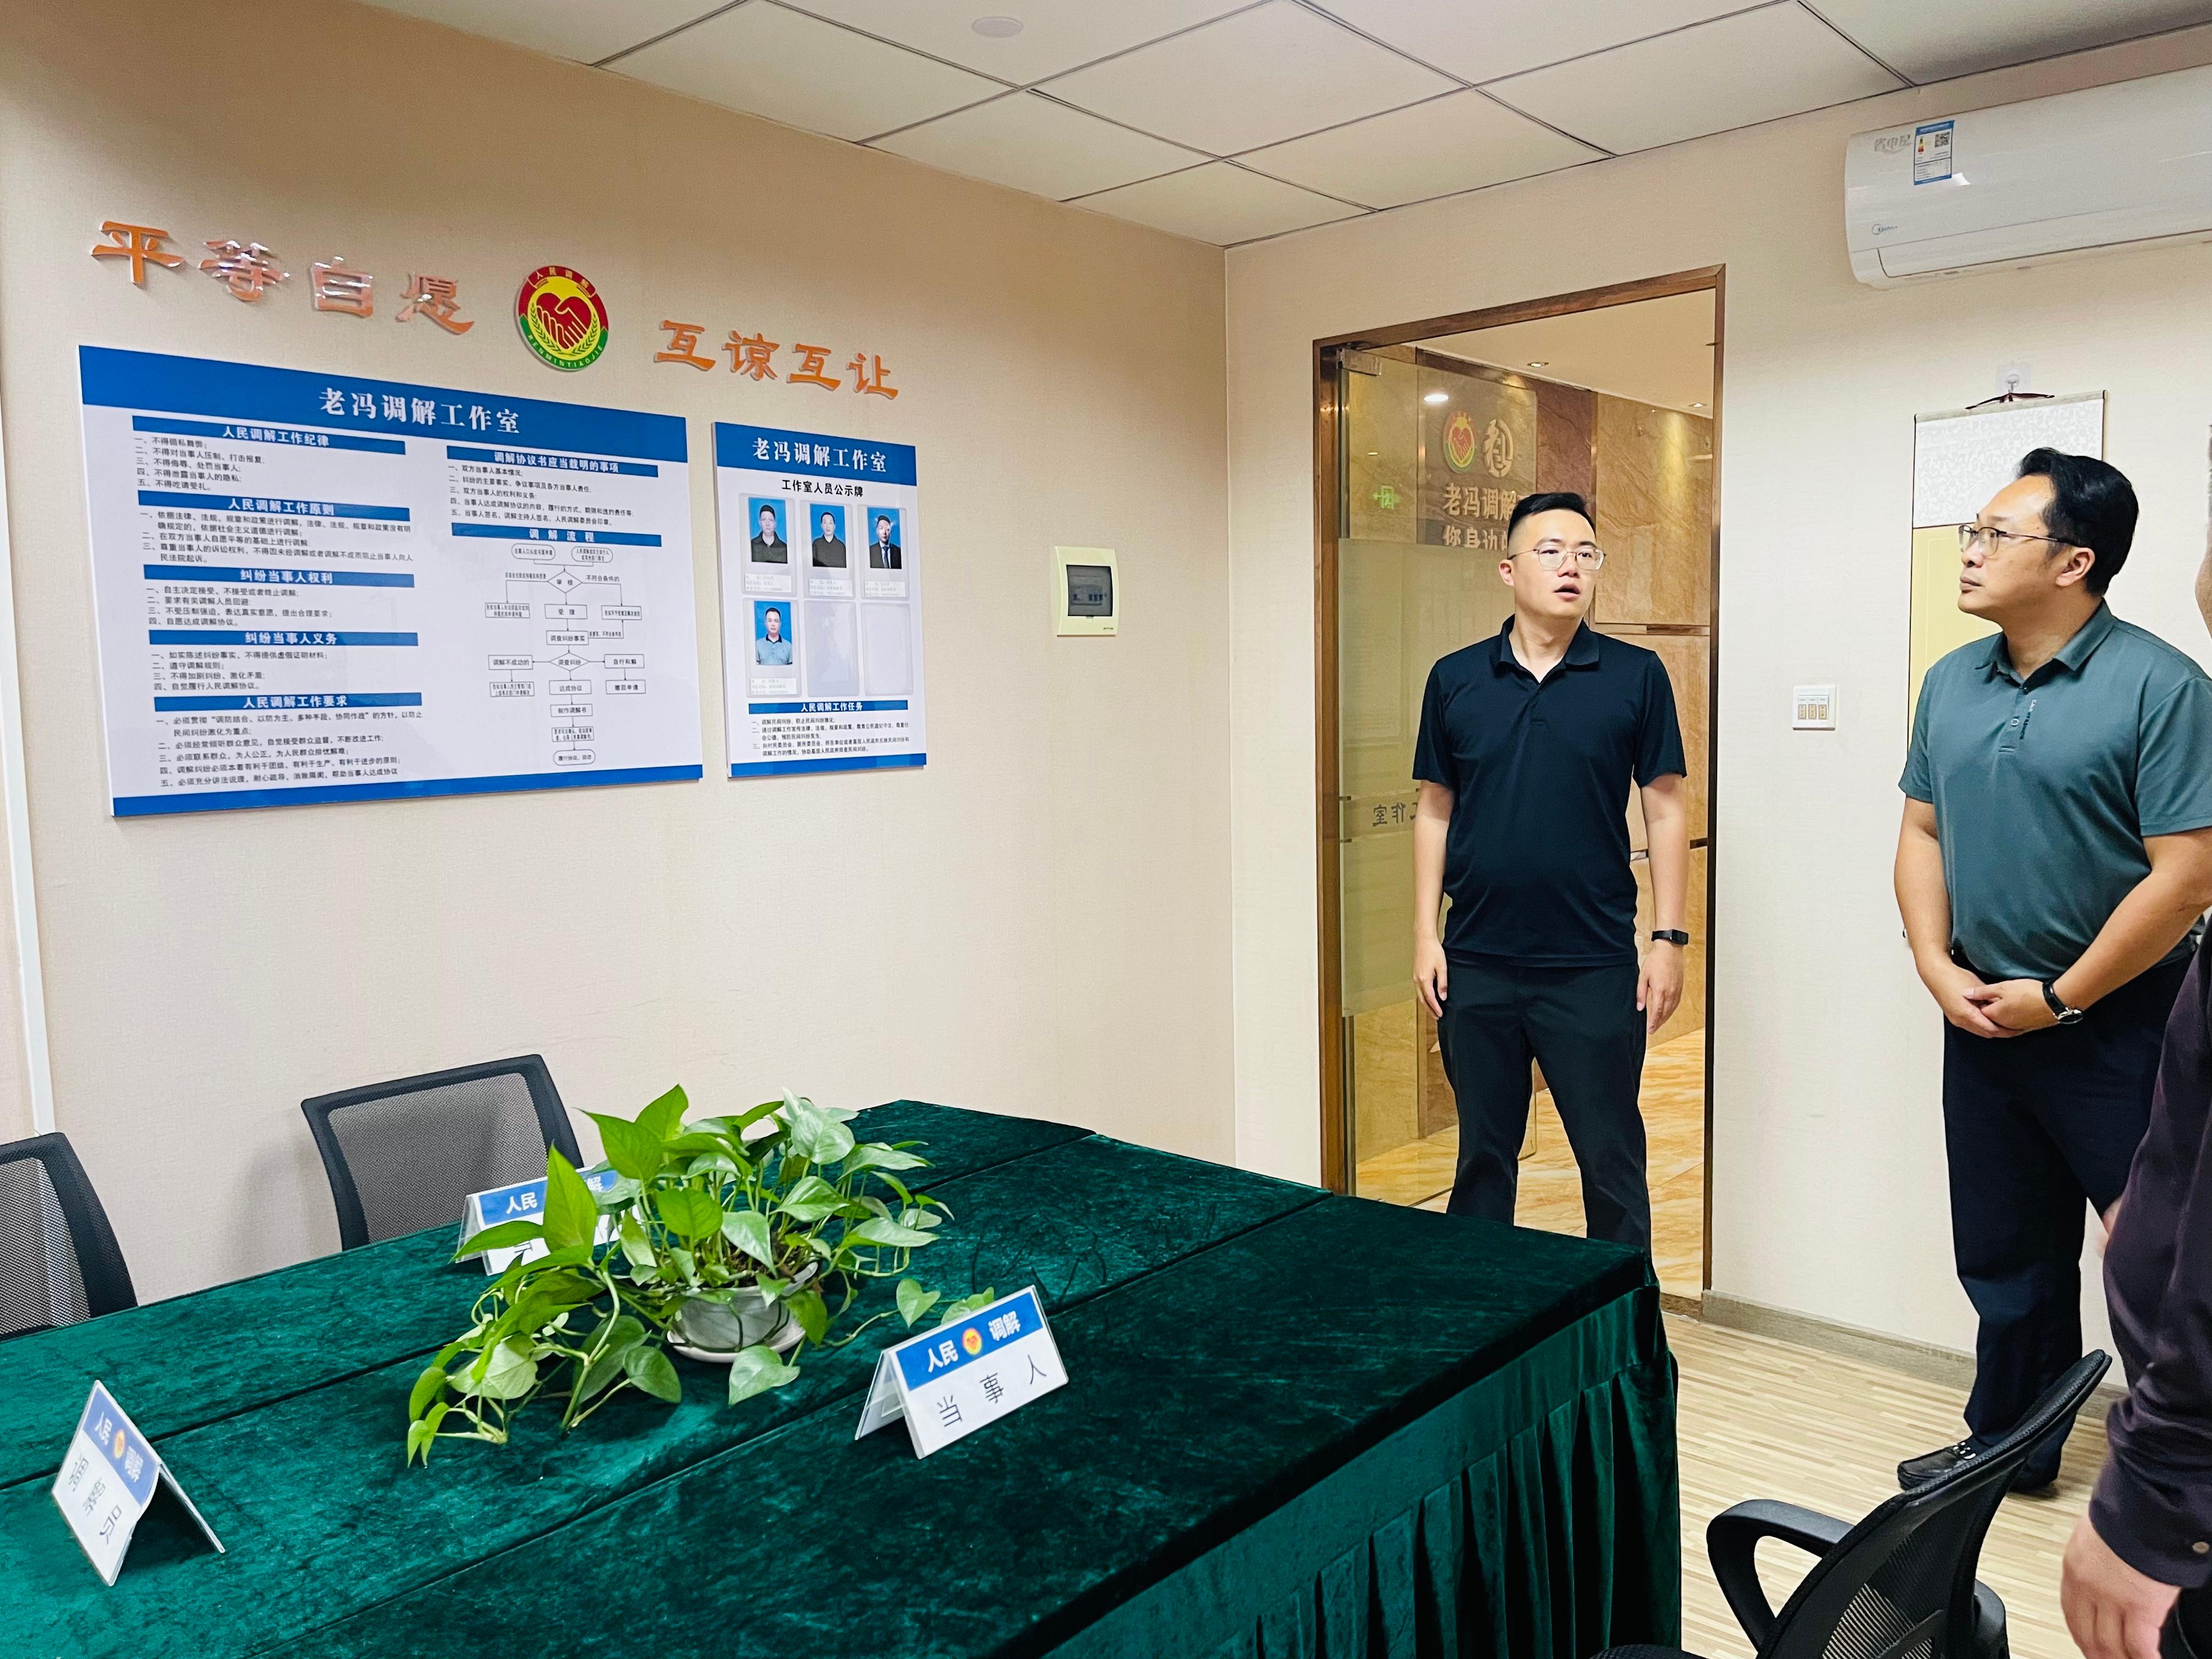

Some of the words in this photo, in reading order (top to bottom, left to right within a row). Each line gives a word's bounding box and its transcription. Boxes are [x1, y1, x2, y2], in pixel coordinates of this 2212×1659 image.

[91, 221, 475, 335] 平等自愿
[654, 319, 899, 400] 互谅互让
[318, 387, 520, 433] 老冯调解工作室
[222, 425, 330, 447] 人民调解工作纪律
[494, 452, 619, 473] 调解协议书应当载明的事项
[752, 437, 887, 472] 老冯调解工作室
[782, 479, 864, 498] 工作室人员公示牌
[228, 498, 335, 516] 人民调解工作原则
[1442, 482, 1530, 520] 老冯调解
[240, 569, 333, 584] 纠纷当事人权利
[586, 574, 620, 583] 不符合条件的
[245, 631, 337, 645] 纠纷当事人义务
[242, 695, 347, 709] 人民调解工作要求
[800, 702, 863, 712] 人民调解工作任务
[505, 1192, 538, 1215] 人民
[584, 1175, 604, 1192] 解
[928, 1339, 959, 1373] 人民
[988, 1310, 1022, 1342] 调解
[936, 1354, 1047, 1427] 当事人
[94, 1411, 112, 1446] 人民
